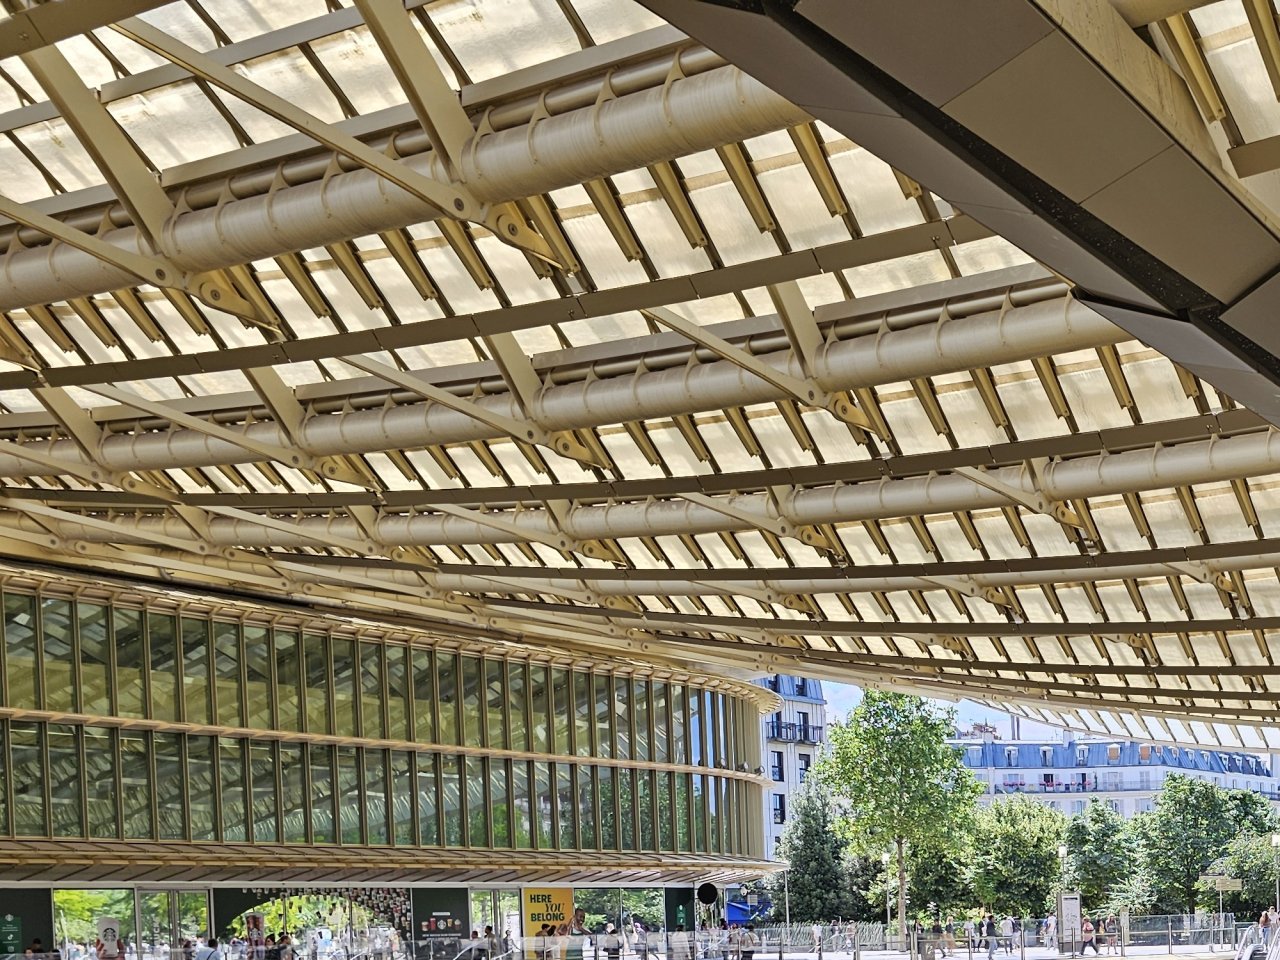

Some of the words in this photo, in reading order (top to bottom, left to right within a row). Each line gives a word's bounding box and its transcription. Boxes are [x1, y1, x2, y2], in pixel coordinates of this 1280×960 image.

[529, 894, 552, 903] HERE
[545, 903, 565, 912] YOU
[530, 912, 565, 922] BELONG
